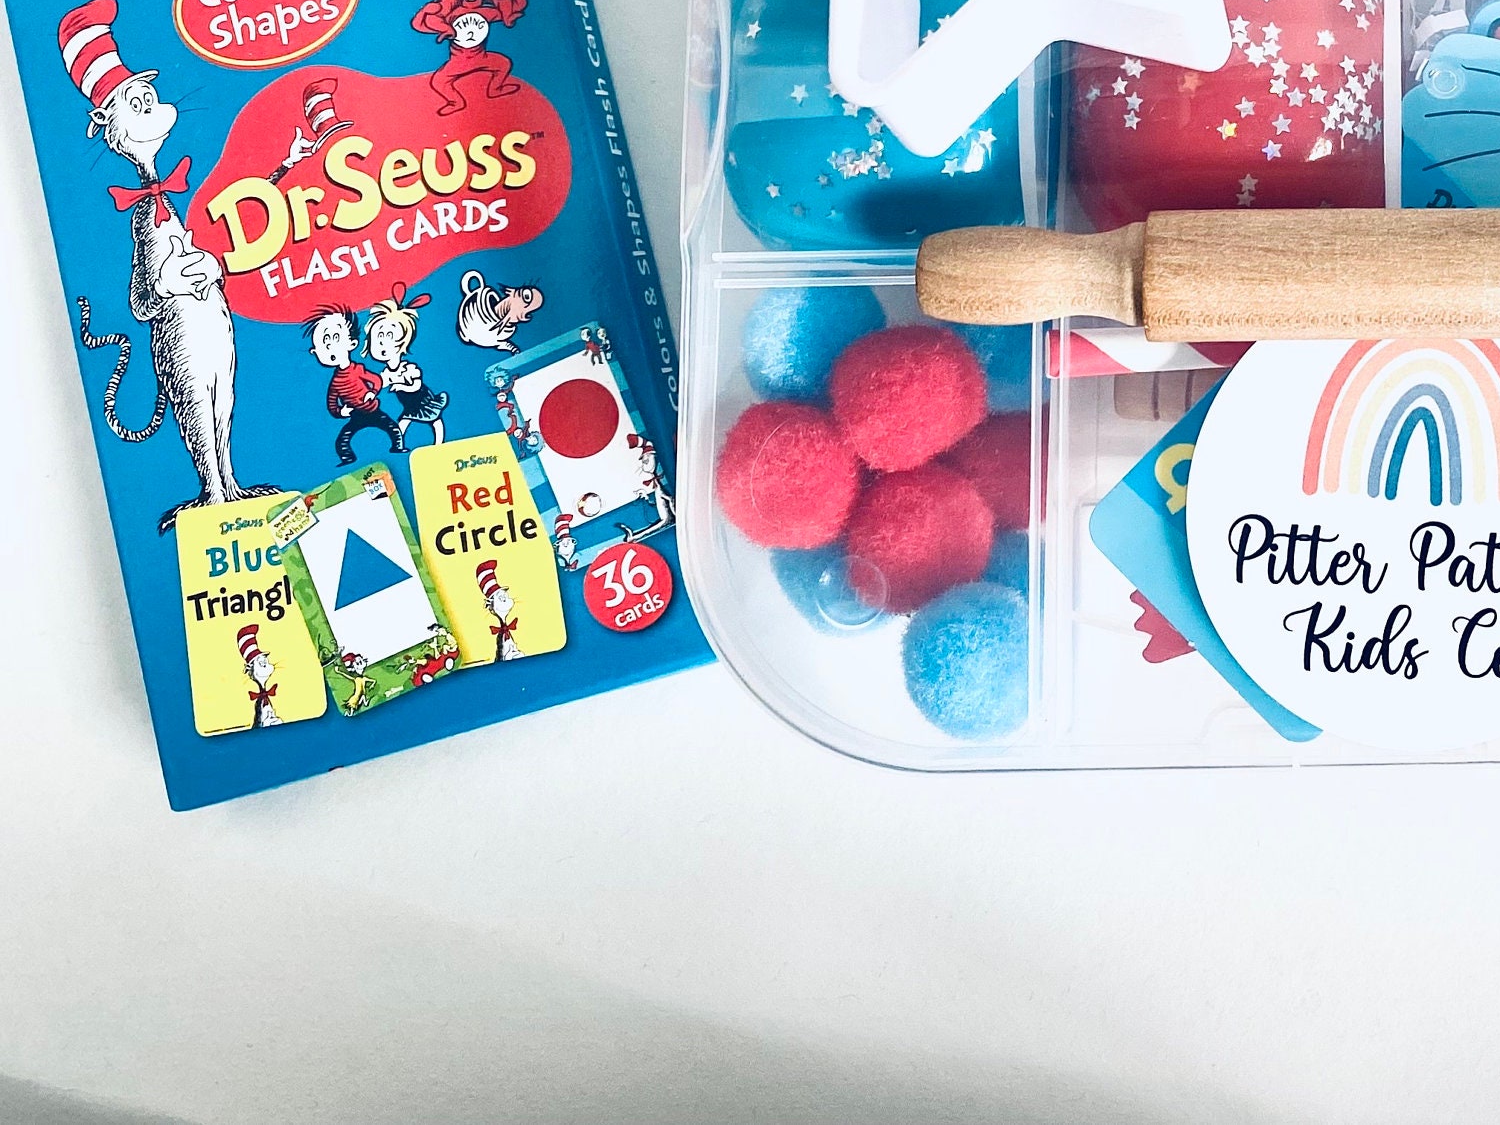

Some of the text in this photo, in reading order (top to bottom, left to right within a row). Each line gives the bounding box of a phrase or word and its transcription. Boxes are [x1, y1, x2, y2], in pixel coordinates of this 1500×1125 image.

[454, 16, 486, 30] THING
[465, 31, 477, 42] 2
[595, 78, 622, 156] Flash
[324, 130, 538, 233] Seuss
[618, 165, 651, 276] Shapes
[257, 199, 509, 297] FLASH CARDS
[644, 287, 657, 306] &
[653, 316, 678, 412] Colors
[447, 471, 514, 514] Red
[206, 540, 283, 577] Blue
[435, 510, 538, 556] Circle
[1228, 513, 1388, 594] Pitter
[187, 574, 292, 621] Triangl
[591, 548, 654, 608] 36
[614, 593, 665, 627] cards
[1283, 601, 1429, 679] Kids
